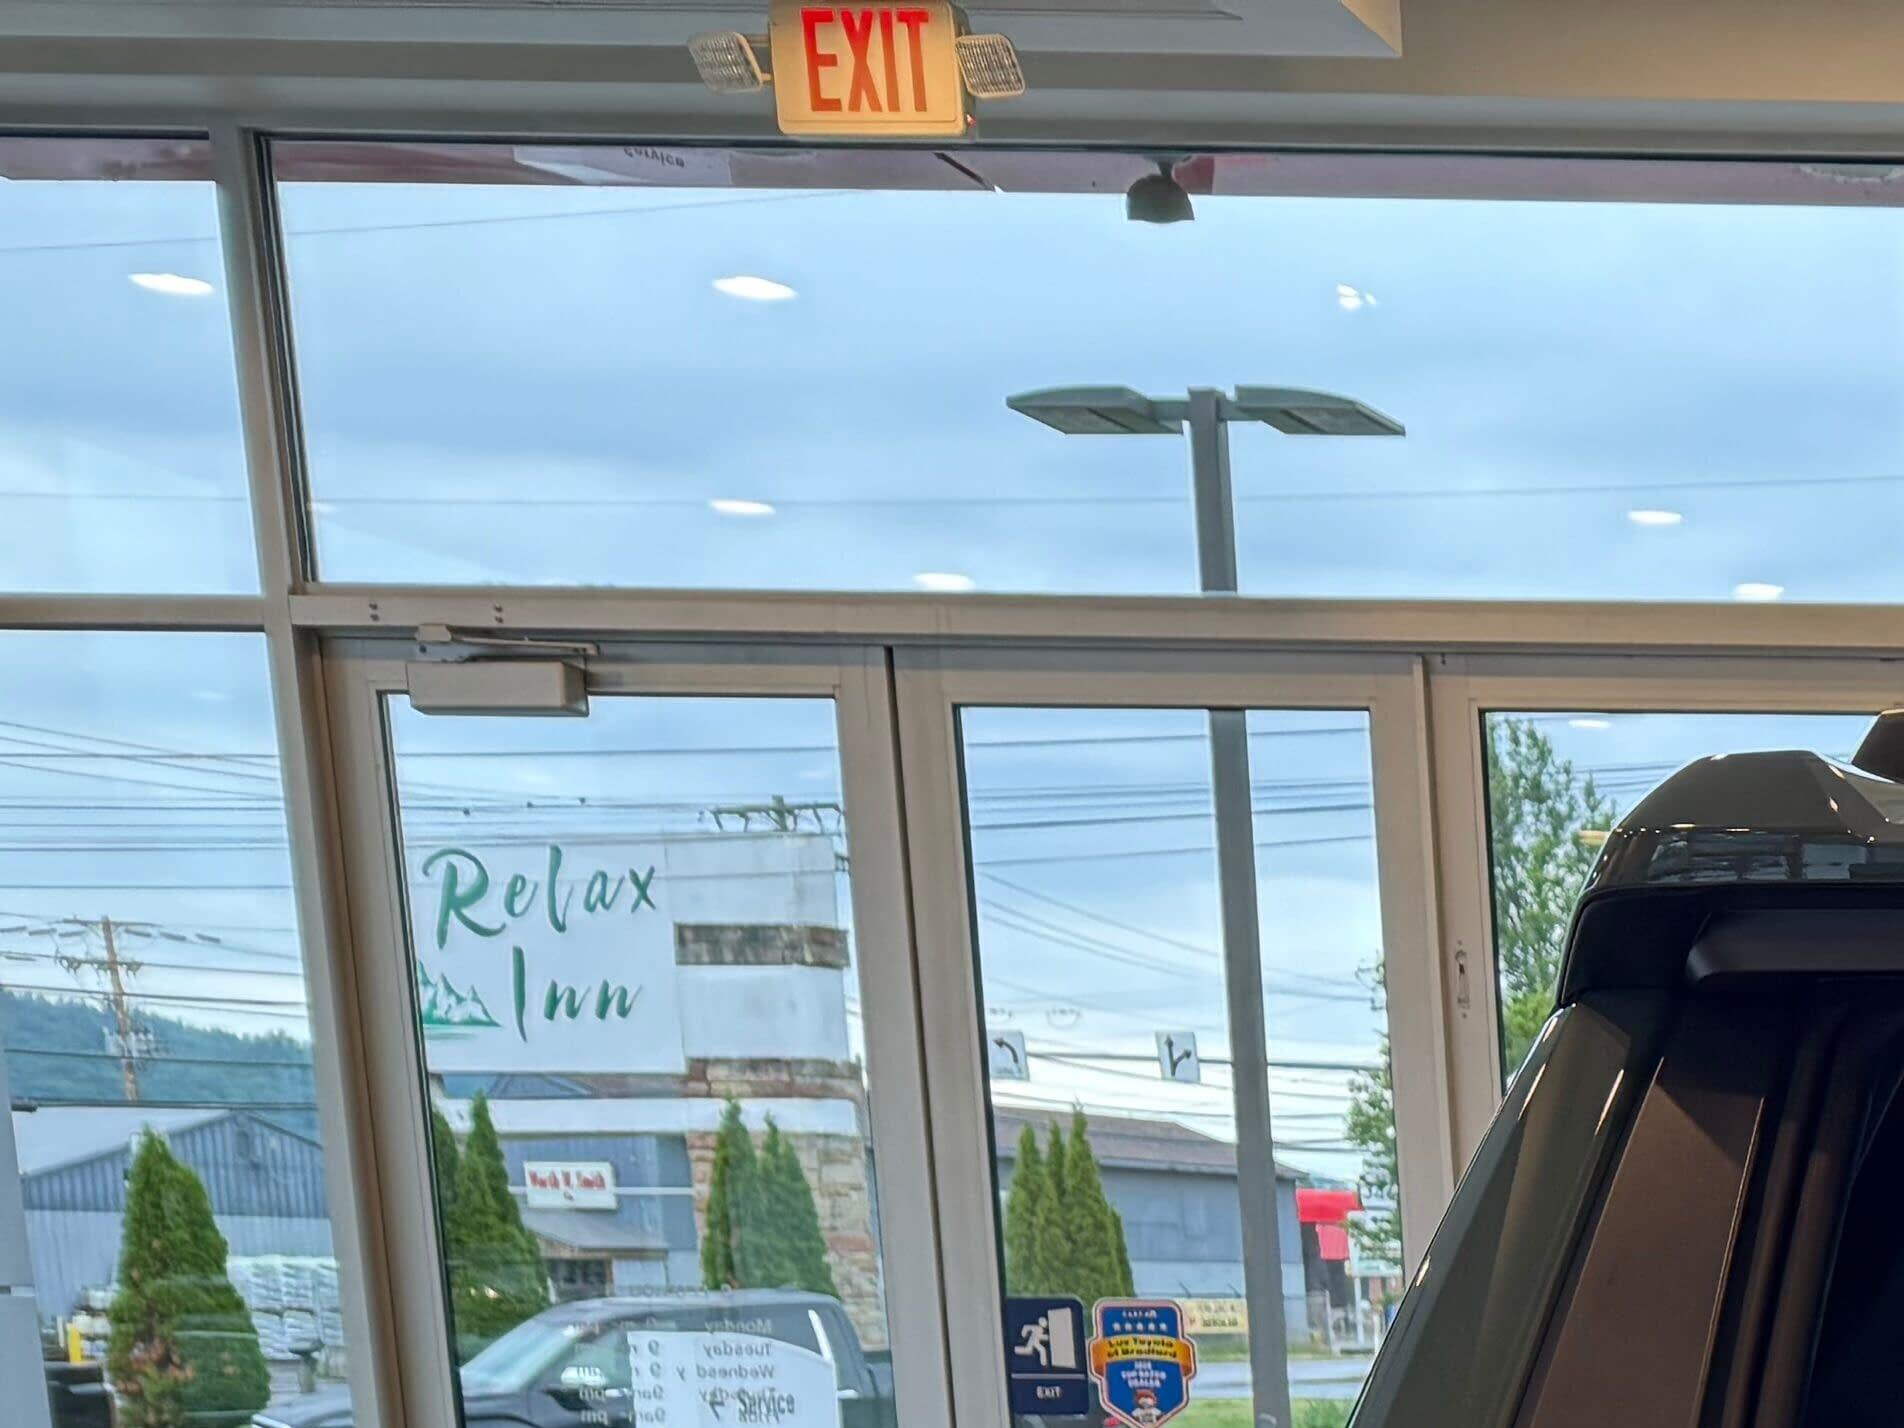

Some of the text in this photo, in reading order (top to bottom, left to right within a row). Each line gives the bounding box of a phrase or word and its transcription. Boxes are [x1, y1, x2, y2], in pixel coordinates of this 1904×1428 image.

[800, 9, 929, 113] EXIT
[422, 845, 656, 950] Relax
[512, 945, 643, 1043] Inn
[1036, 1385, 1062, 1399] EXIT
